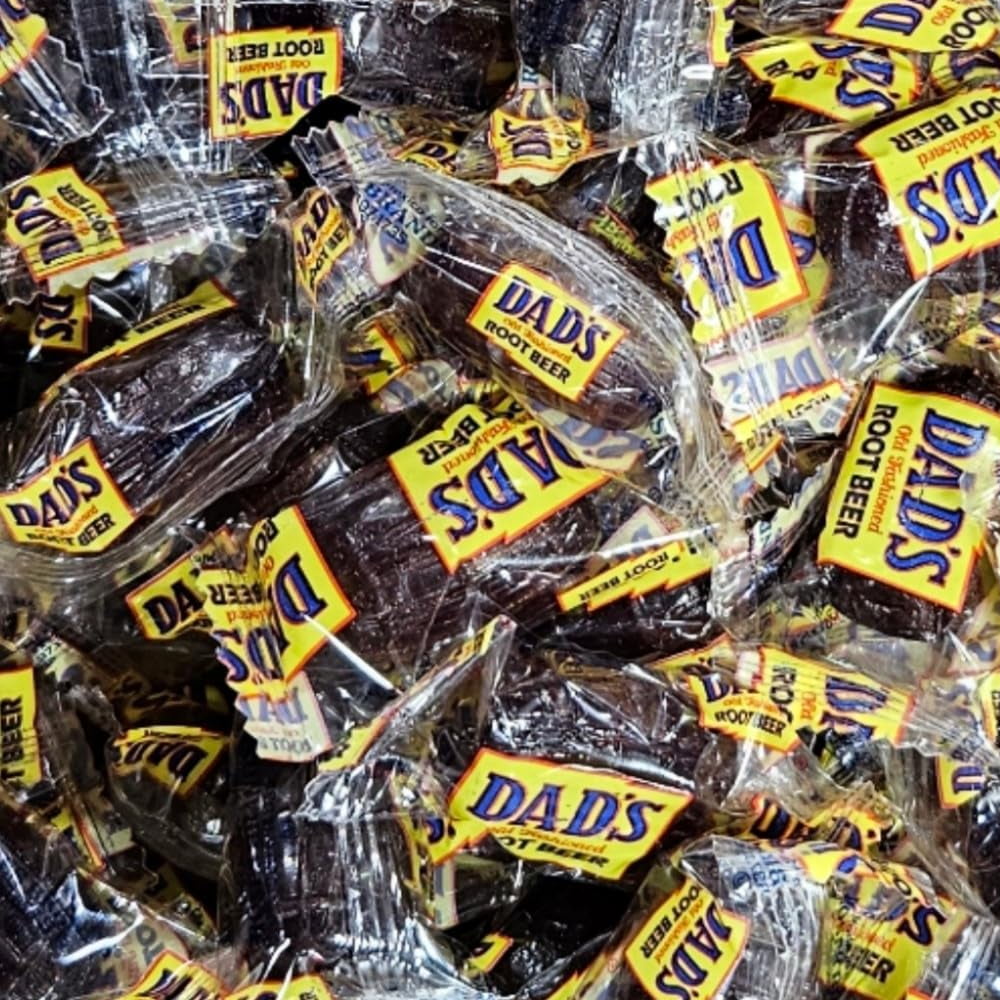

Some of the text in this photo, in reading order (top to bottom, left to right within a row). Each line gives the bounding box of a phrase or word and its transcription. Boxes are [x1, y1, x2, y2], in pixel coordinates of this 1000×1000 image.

[227, 37, 325, 63] ROOT BEER
[220, 71, 328, 126] DAD'S
[890, 115, 957, 153] BEER
[916, 123, 991, 167] Fashioned
[492, 274, 612, 362] DAD'S
[484, 320, 571, 385] ROOT BEER
[420, 417, 481, 466] BEER
[10, 457, 104, 529] DAD'S
[834, 403, 898, 540] ROOT BEER
[878, 455, 906, 535] Fashioned
[885, 407, 989, 589] DAD'S
[77, 515, 115, 548] BEER
[469, 773, 665, 845] DAD'S
[541, 841, 610, 868] BEER
[641, 919, 674, 960] BEER
